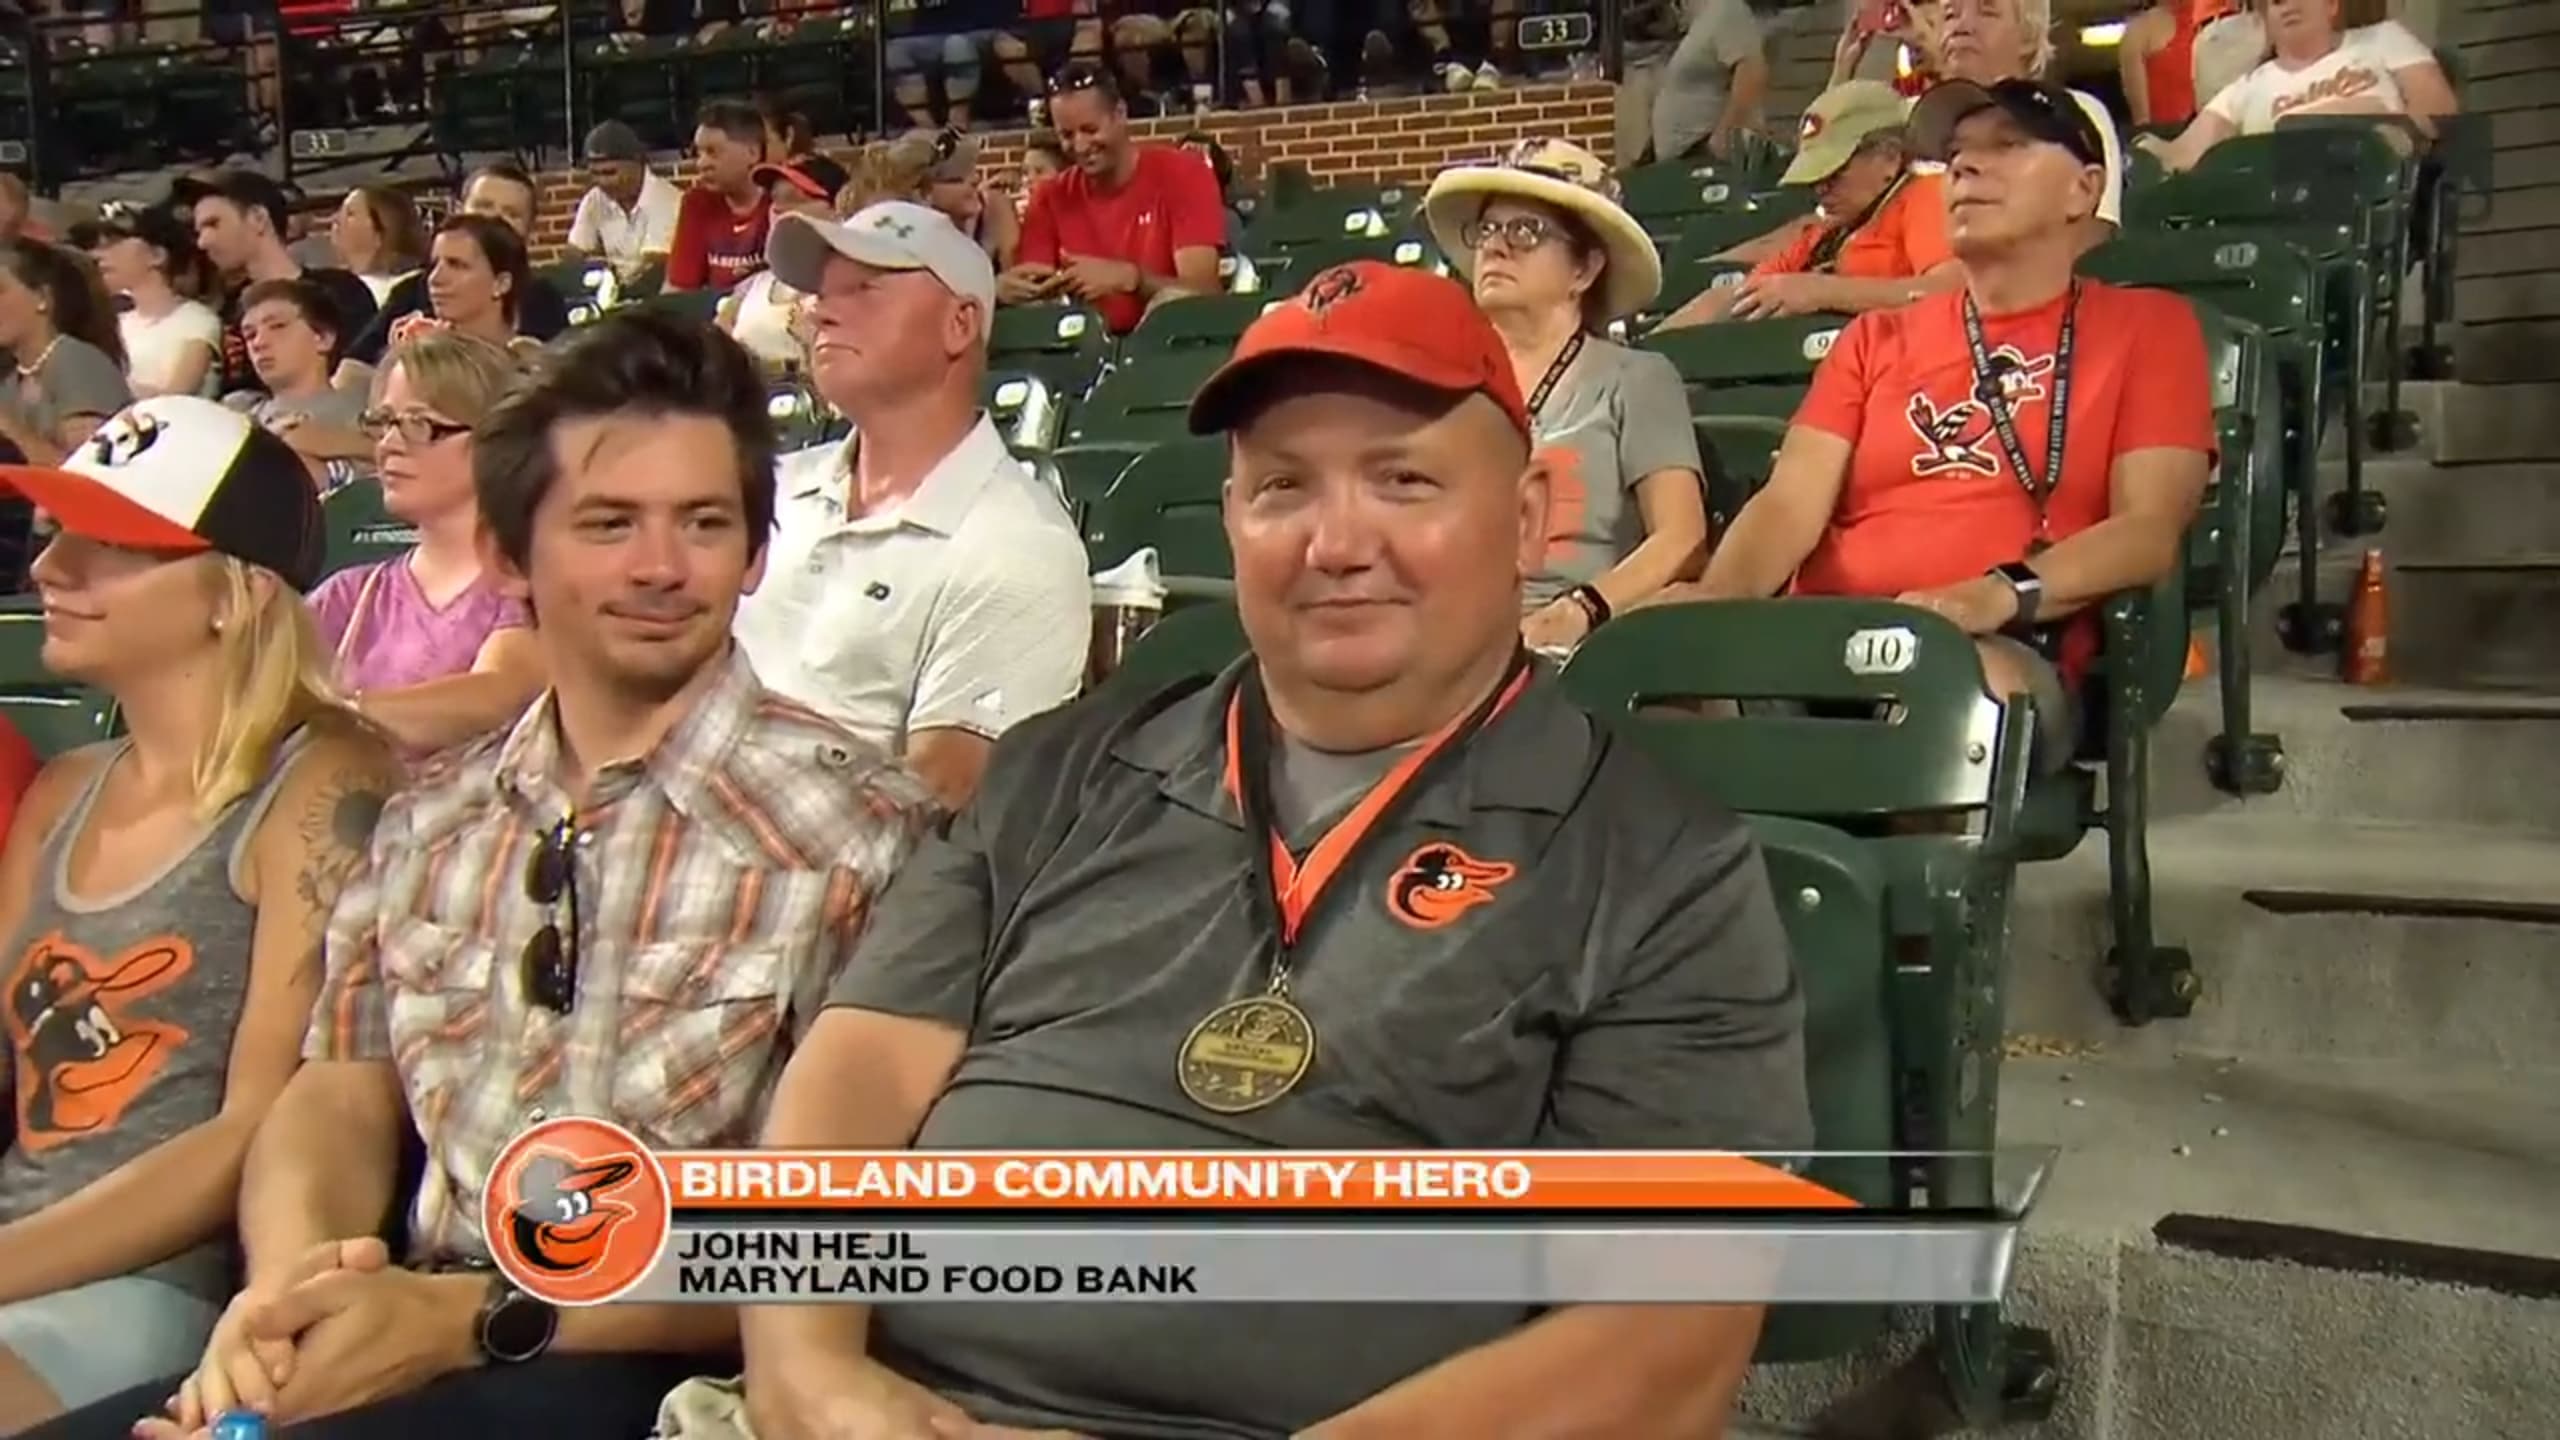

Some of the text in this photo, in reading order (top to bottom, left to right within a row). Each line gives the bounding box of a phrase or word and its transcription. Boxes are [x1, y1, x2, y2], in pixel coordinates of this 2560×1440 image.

[1541, 19, 1568, 43] 33
[309, 132, 329, 154] 33
[1865, 635, 1902, 668] 10
